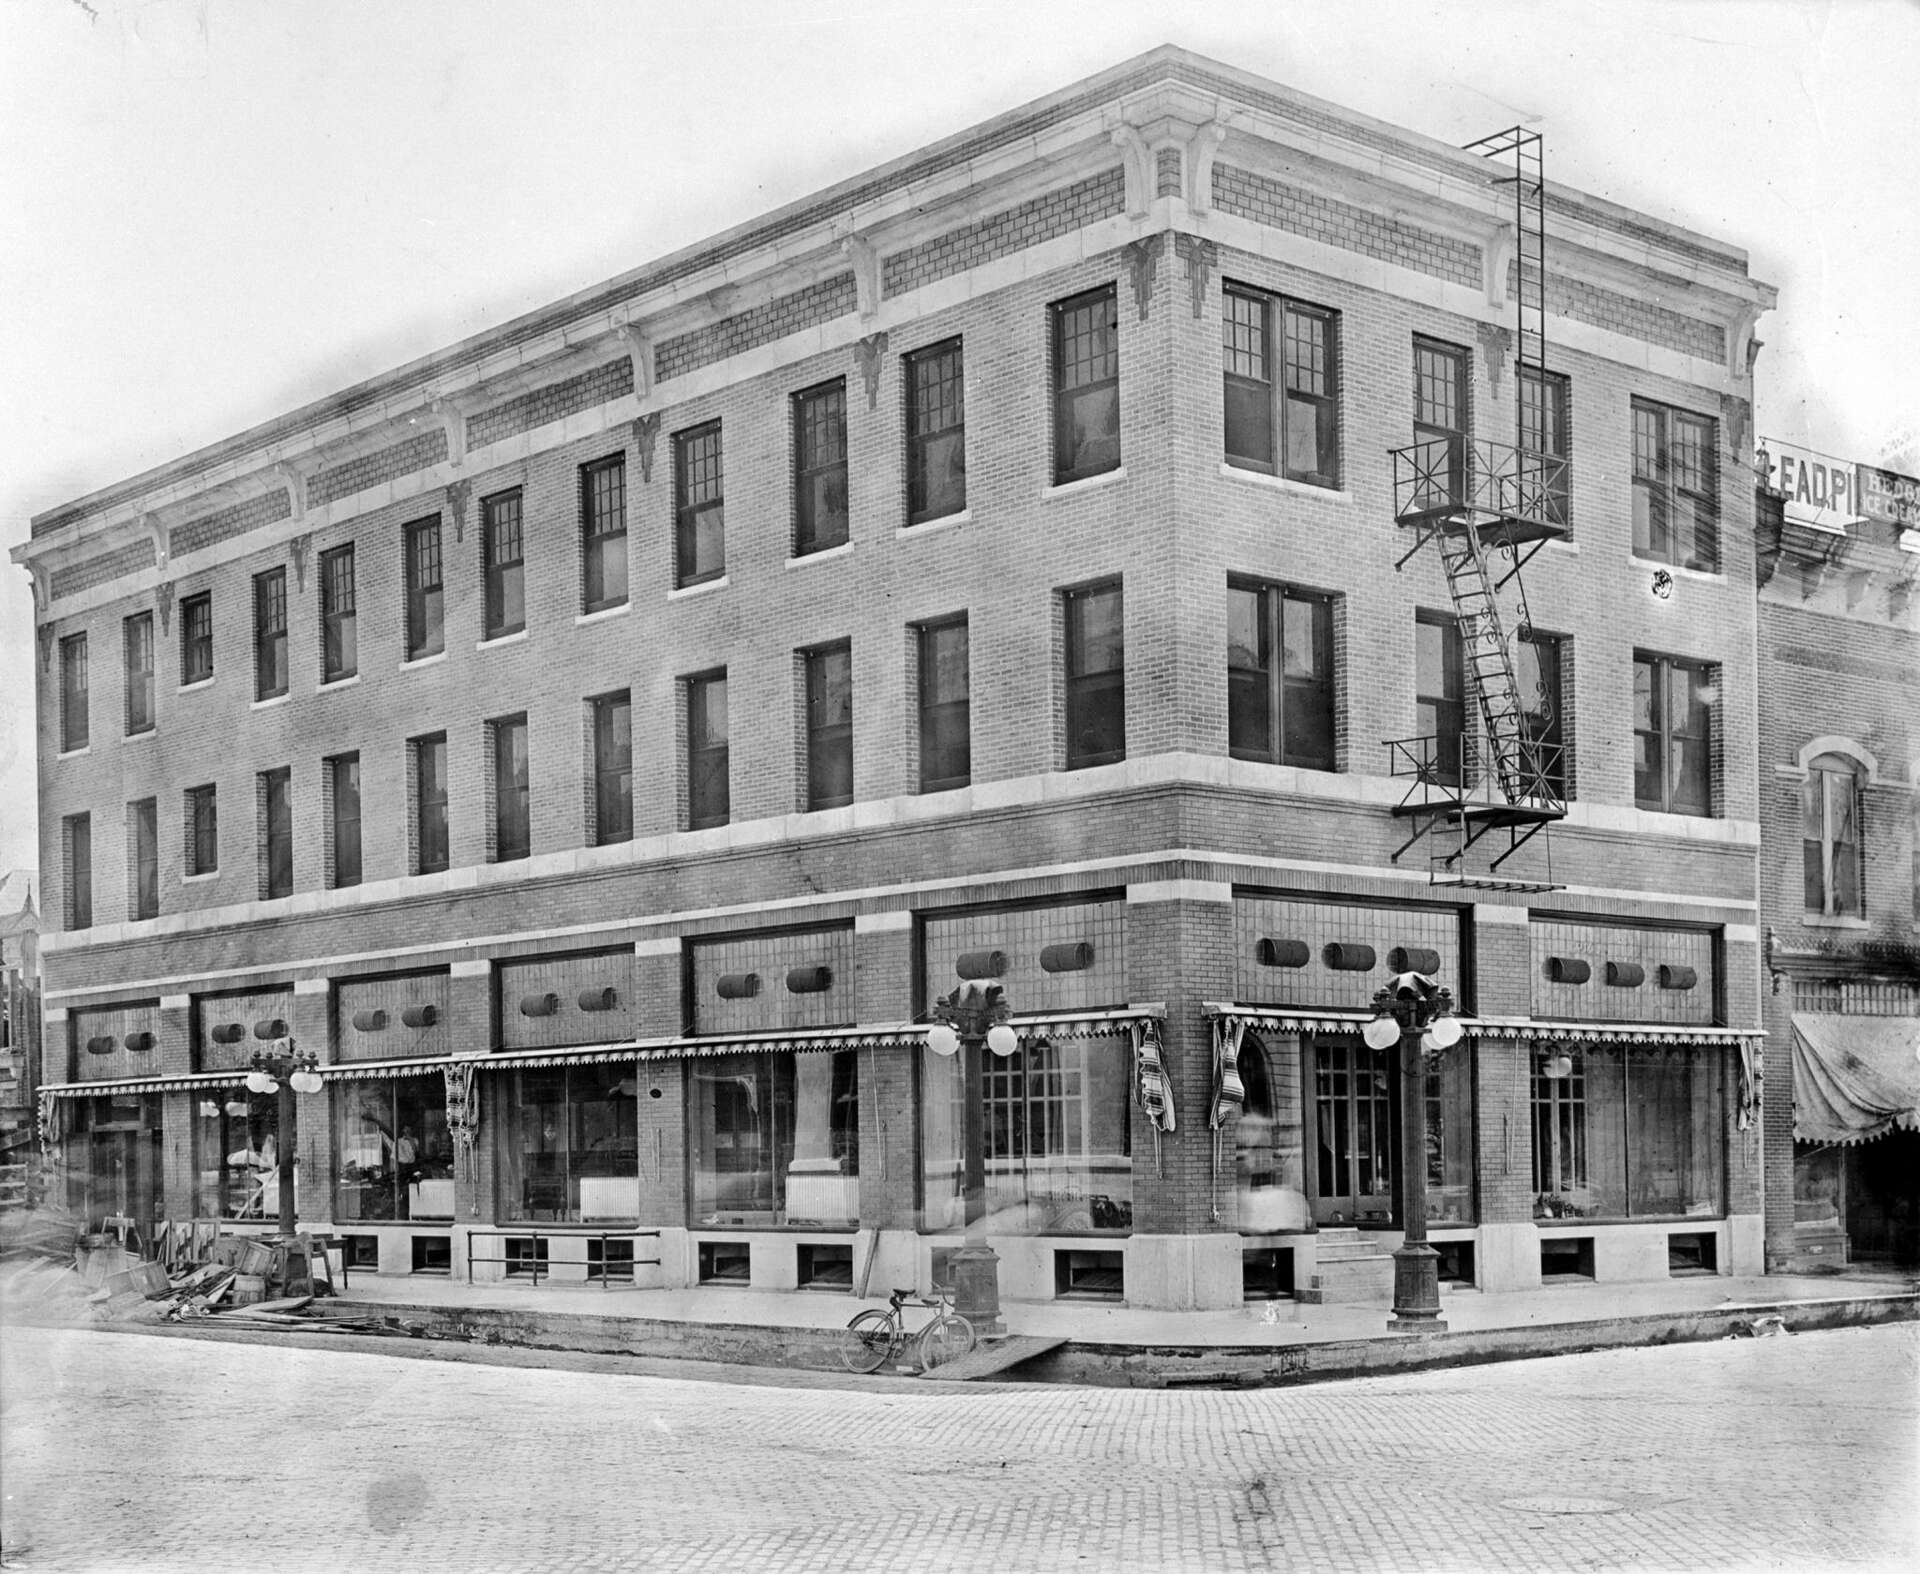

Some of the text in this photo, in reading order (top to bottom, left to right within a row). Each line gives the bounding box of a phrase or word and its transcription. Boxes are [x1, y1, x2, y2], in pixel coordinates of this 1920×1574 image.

[1781, 455, 1857, 516] EAD, PI
[1862, 492, 1881, 515] ICE
